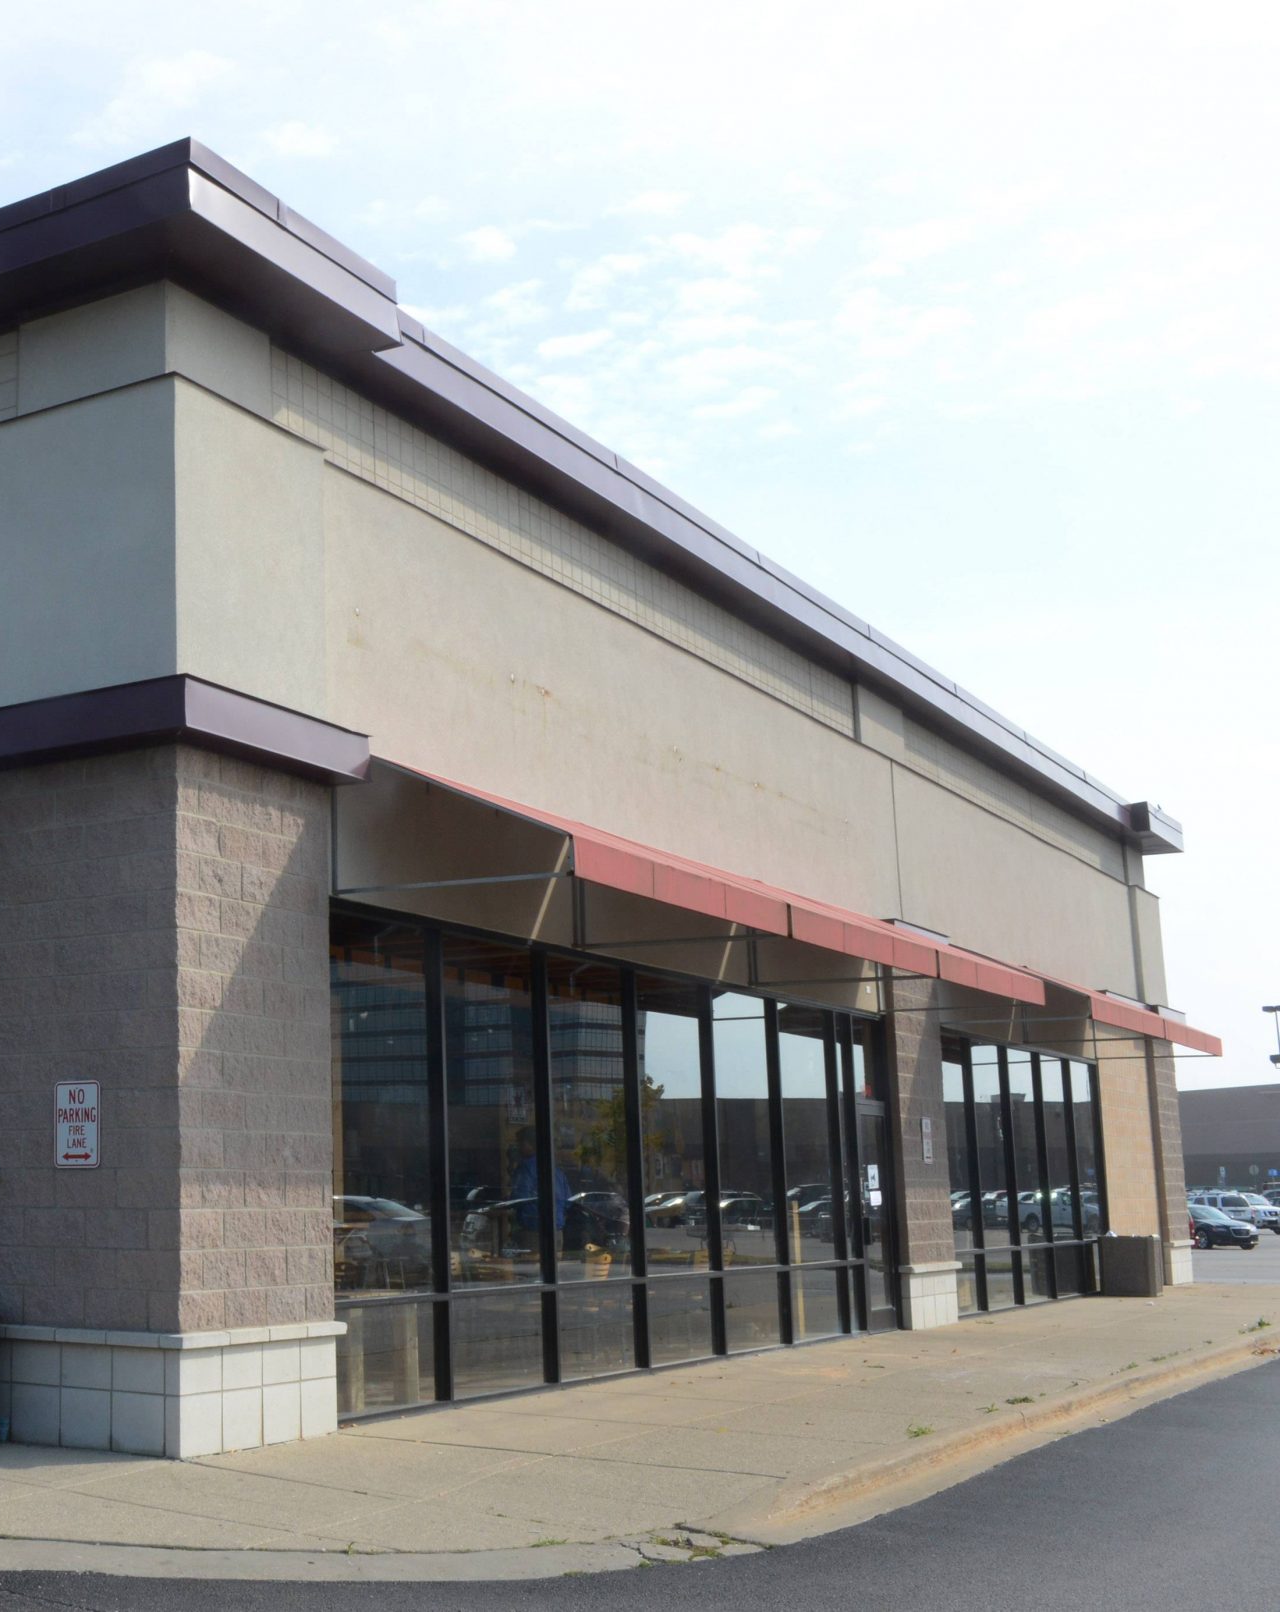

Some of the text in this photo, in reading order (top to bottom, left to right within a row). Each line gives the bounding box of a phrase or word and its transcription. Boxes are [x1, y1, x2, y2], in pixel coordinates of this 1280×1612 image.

[68, 1089, 85, 1105] NO
[57, 1107, 97, 1123] PARKING
[68, 1125, 86, 1136] FIRE
[66, 1138, 88, 1149] LANE
